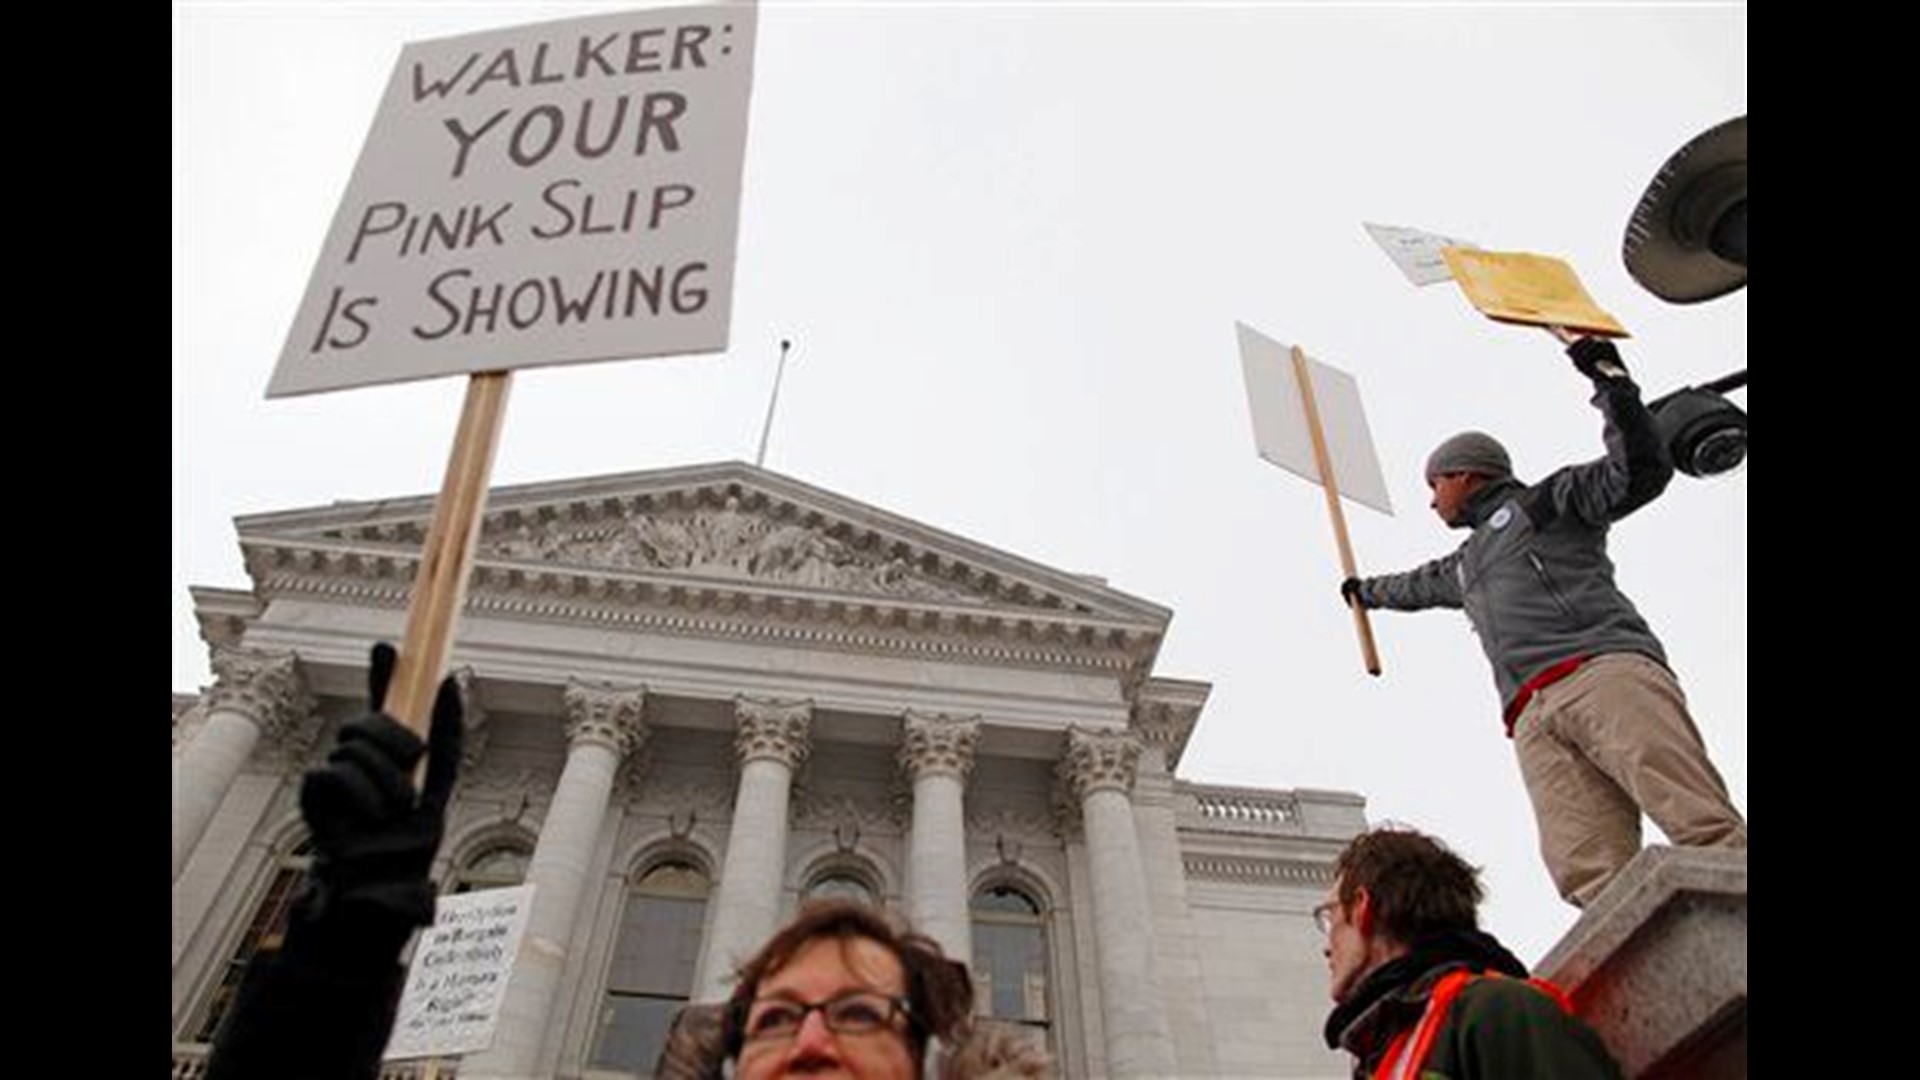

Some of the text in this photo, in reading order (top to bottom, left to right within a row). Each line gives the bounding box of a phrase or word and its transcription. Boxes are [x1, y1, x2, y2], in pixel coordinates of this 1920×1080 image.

[413, 23, 733, 101] WALKER:
[443, 91, 688, 178] YOUR
[345, 180, 695, 264] PINK SLIP
[311, 262, 708, 353] IS SHOWING
